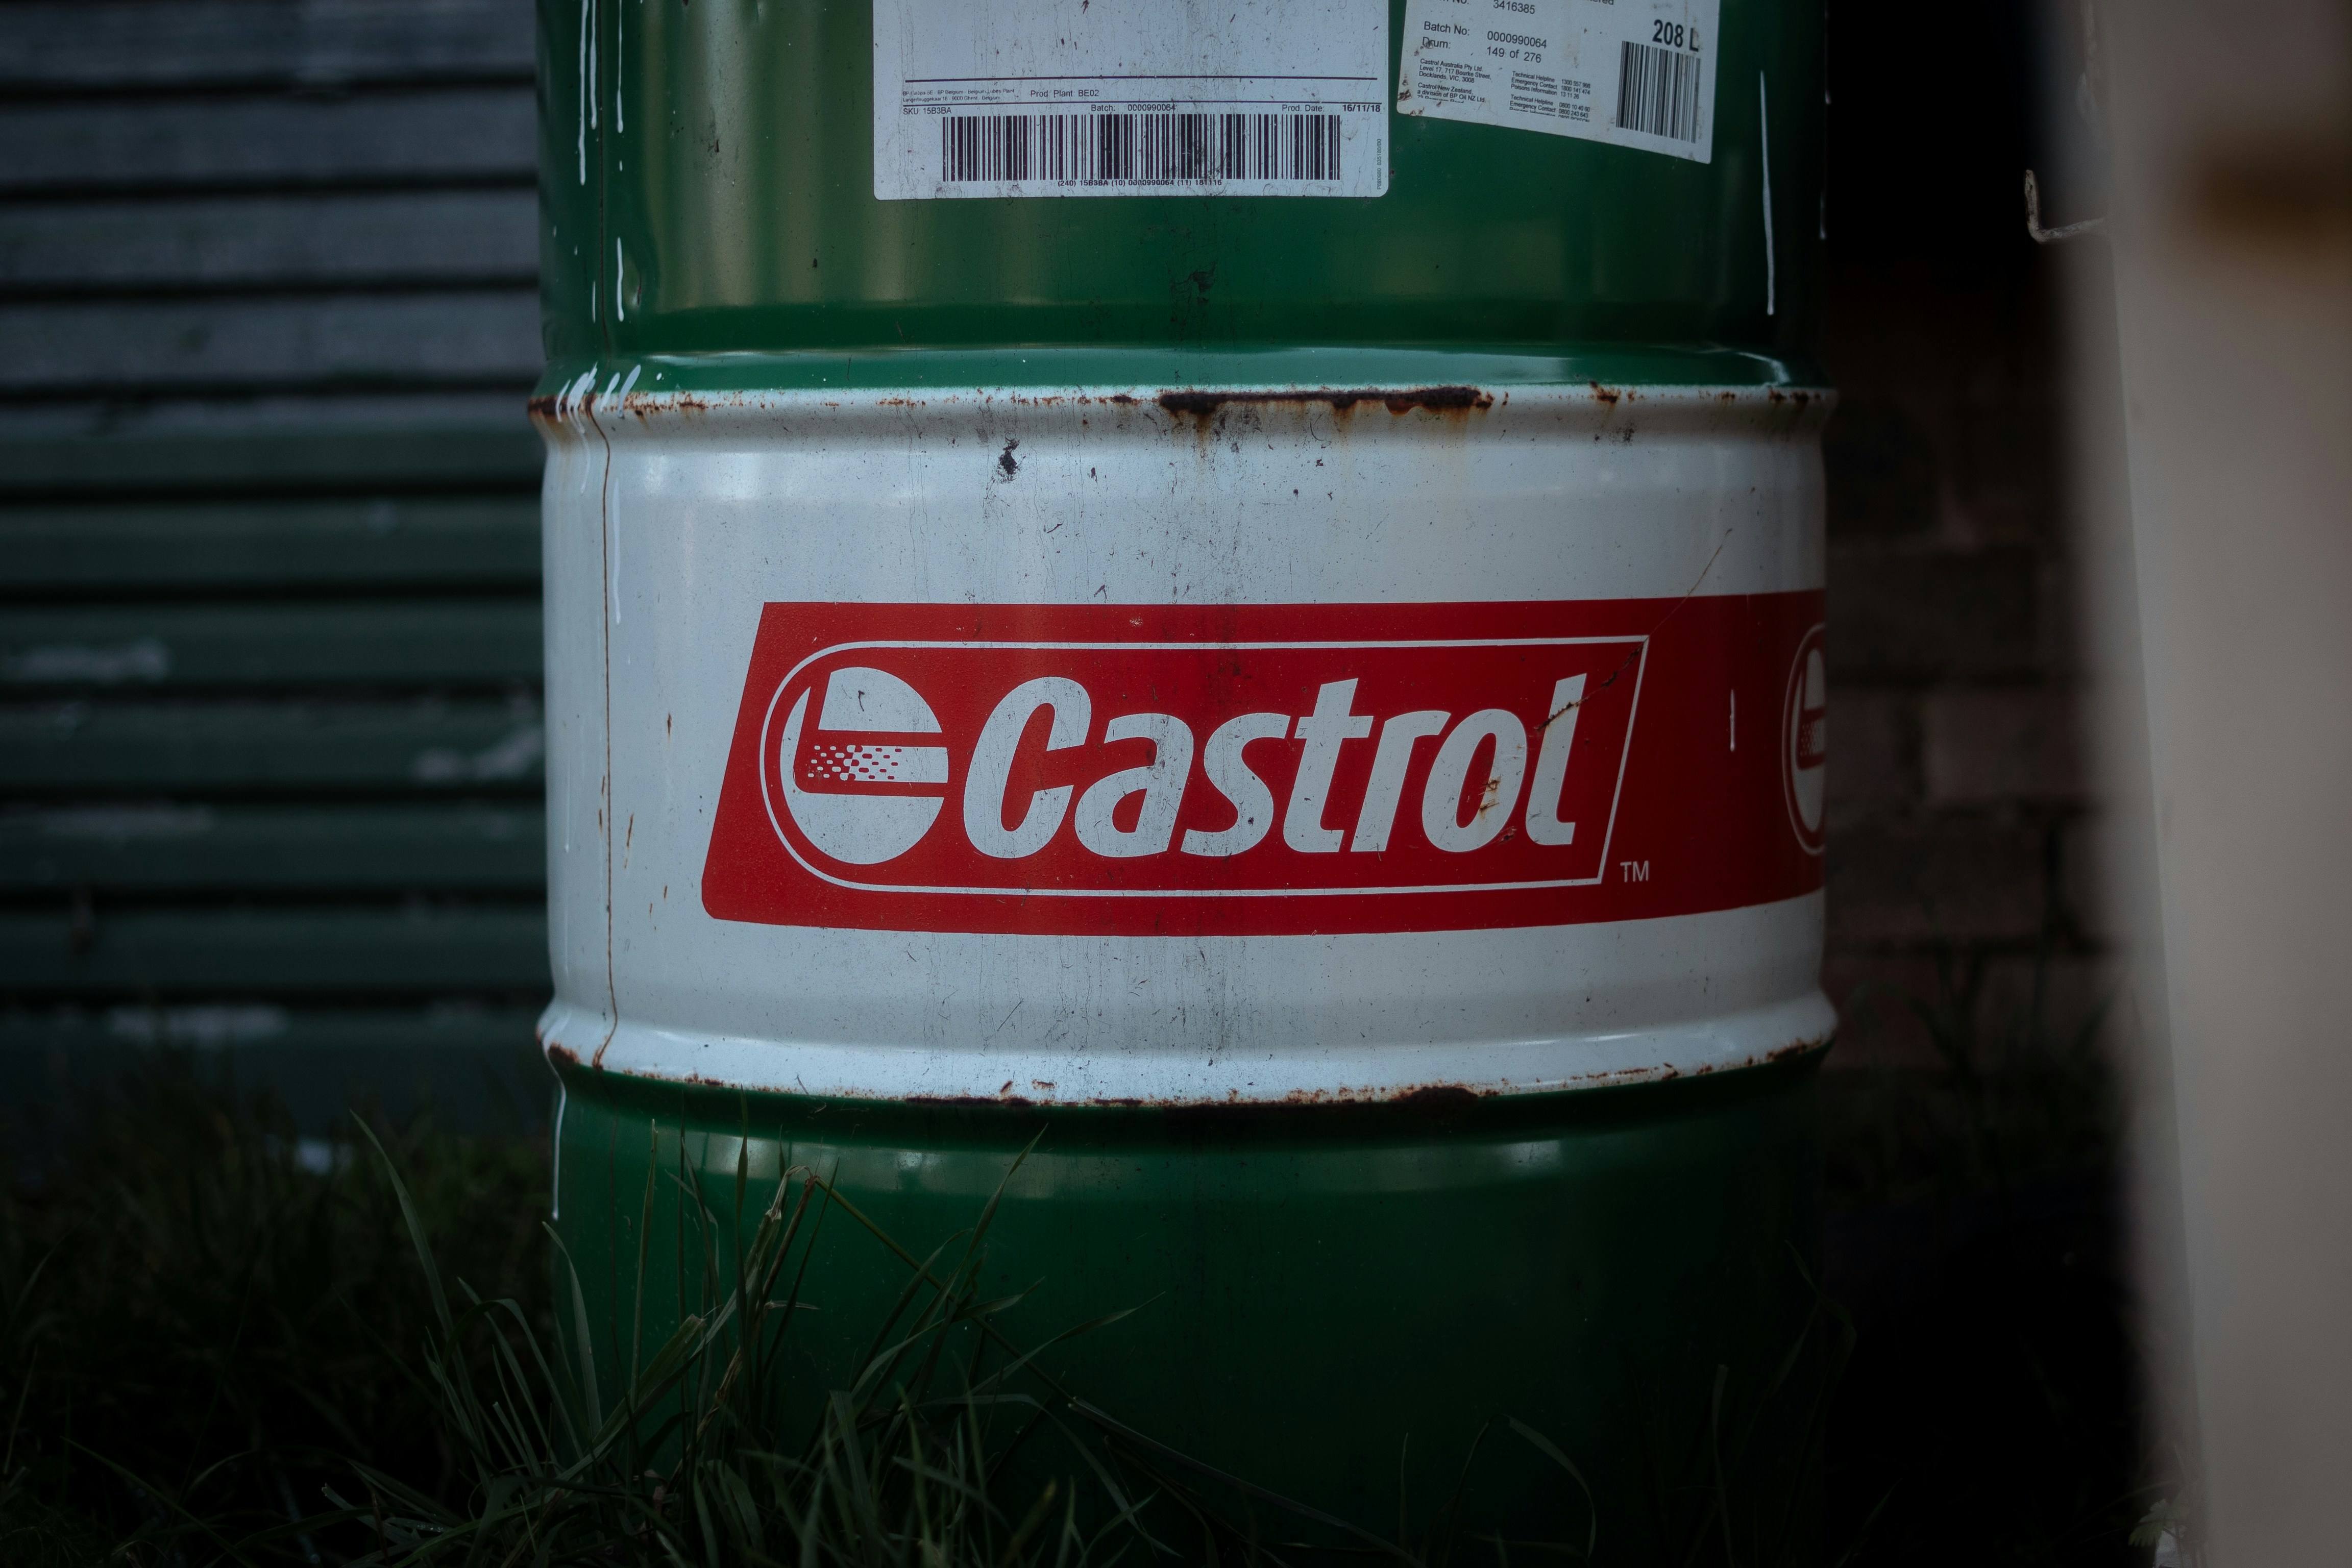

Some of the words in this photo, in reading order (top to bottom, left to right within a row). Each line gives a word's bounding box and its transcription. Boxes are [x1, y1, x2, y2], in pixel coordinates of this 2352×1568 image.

[1493, 0, 1535, 14] 3416385
[1424, 21, 1451, 33] Batch
[1454, 25, 1469, 36] No:
[1487, 31, 1547, 48] 0000990064
[1652, 19, 1683, 48] 208
[1689, 28, 1699, 52] L
[1422, 36, 1451, 49] Drum:
[1487, 46, 1505, 57] 149
[1509, 49, 1520, 59] of
[1524, 52, 1541, 63] 276
[1440, 61, 1463, 69] Australia
[1419, 71, 1448, 80] Docklands,
[1512, 71, 1535, 80] Technical
[1536, 75, 1555, 83] Helpline
[1511, 77, 1538, 87] Emergency
[1539, 82, 1557, 90] Contact
[1511, 83, 1530, 91] Poisons
[1531, 86, 1557, 95] Information
[1511, 94, 1533, 103] Technical
[1534, 97, 1553, 106] Helpline
[1342, 104, 1381, 112] 16/11/18
[1510, 101, 1536, 110] Emergency
[1538, 105, 1556, 113] Contact
[963, 673, 1588, 860] Castrol
[1620, 860, 1649, 883] TM
